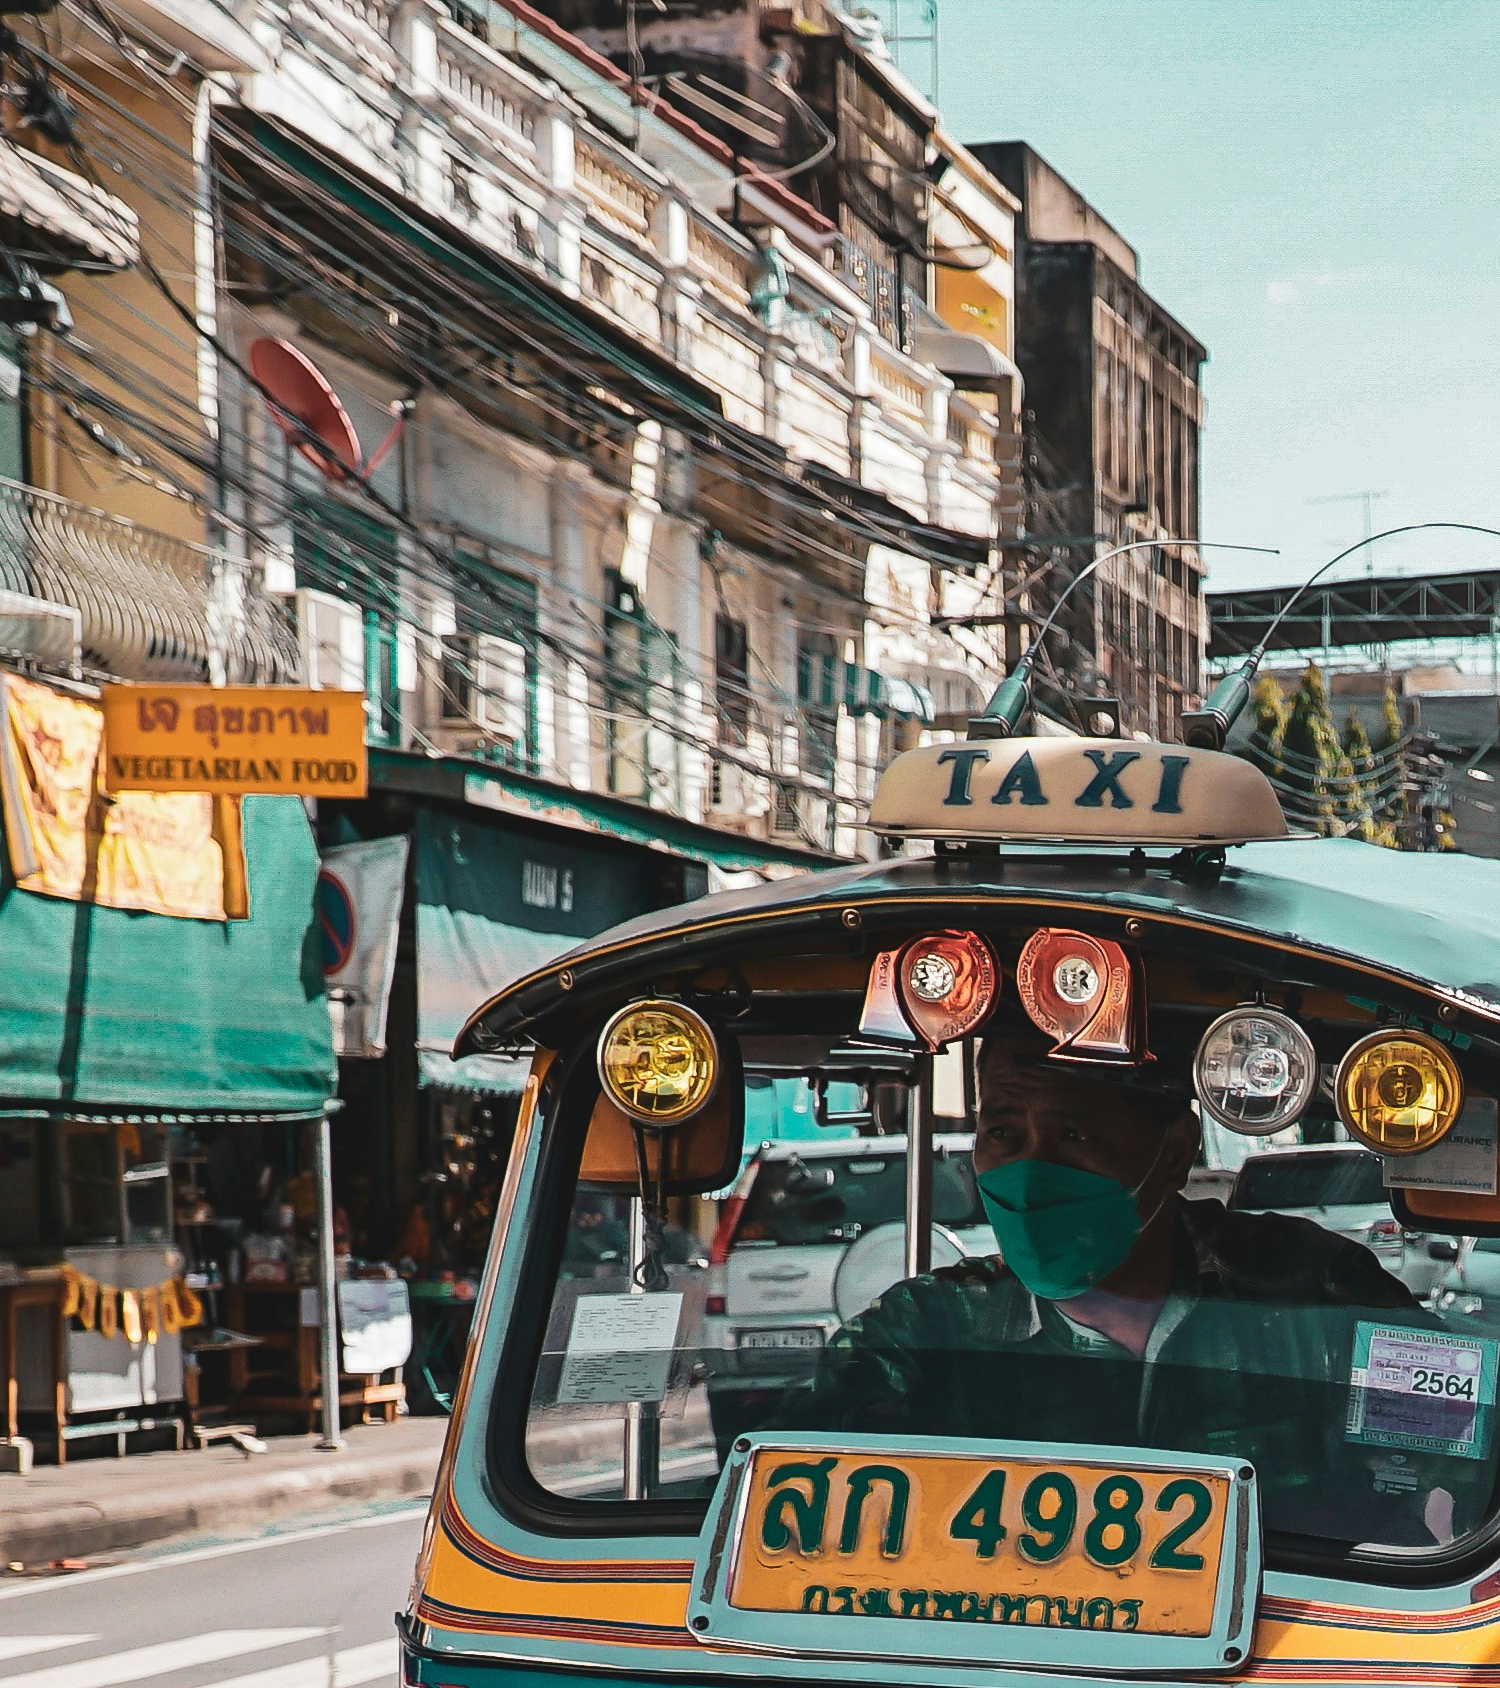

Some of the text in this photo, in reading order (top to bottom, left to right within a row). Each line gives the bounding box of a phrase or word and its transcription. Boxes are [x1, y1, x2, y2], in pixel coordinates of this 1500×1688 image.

[136, 697, 330, 750] เจ สุขภาพ
[109, 755, 359, 785] VEGETARIAN FOOD
[937, 749, 1191, 813] TAXI
[1411, 1370, 1474, 1401] 2564
[761, 1458, 1213, 1571] สก 4982
[803, 1585, 1144, 1631] กรงเทพมหานคร
